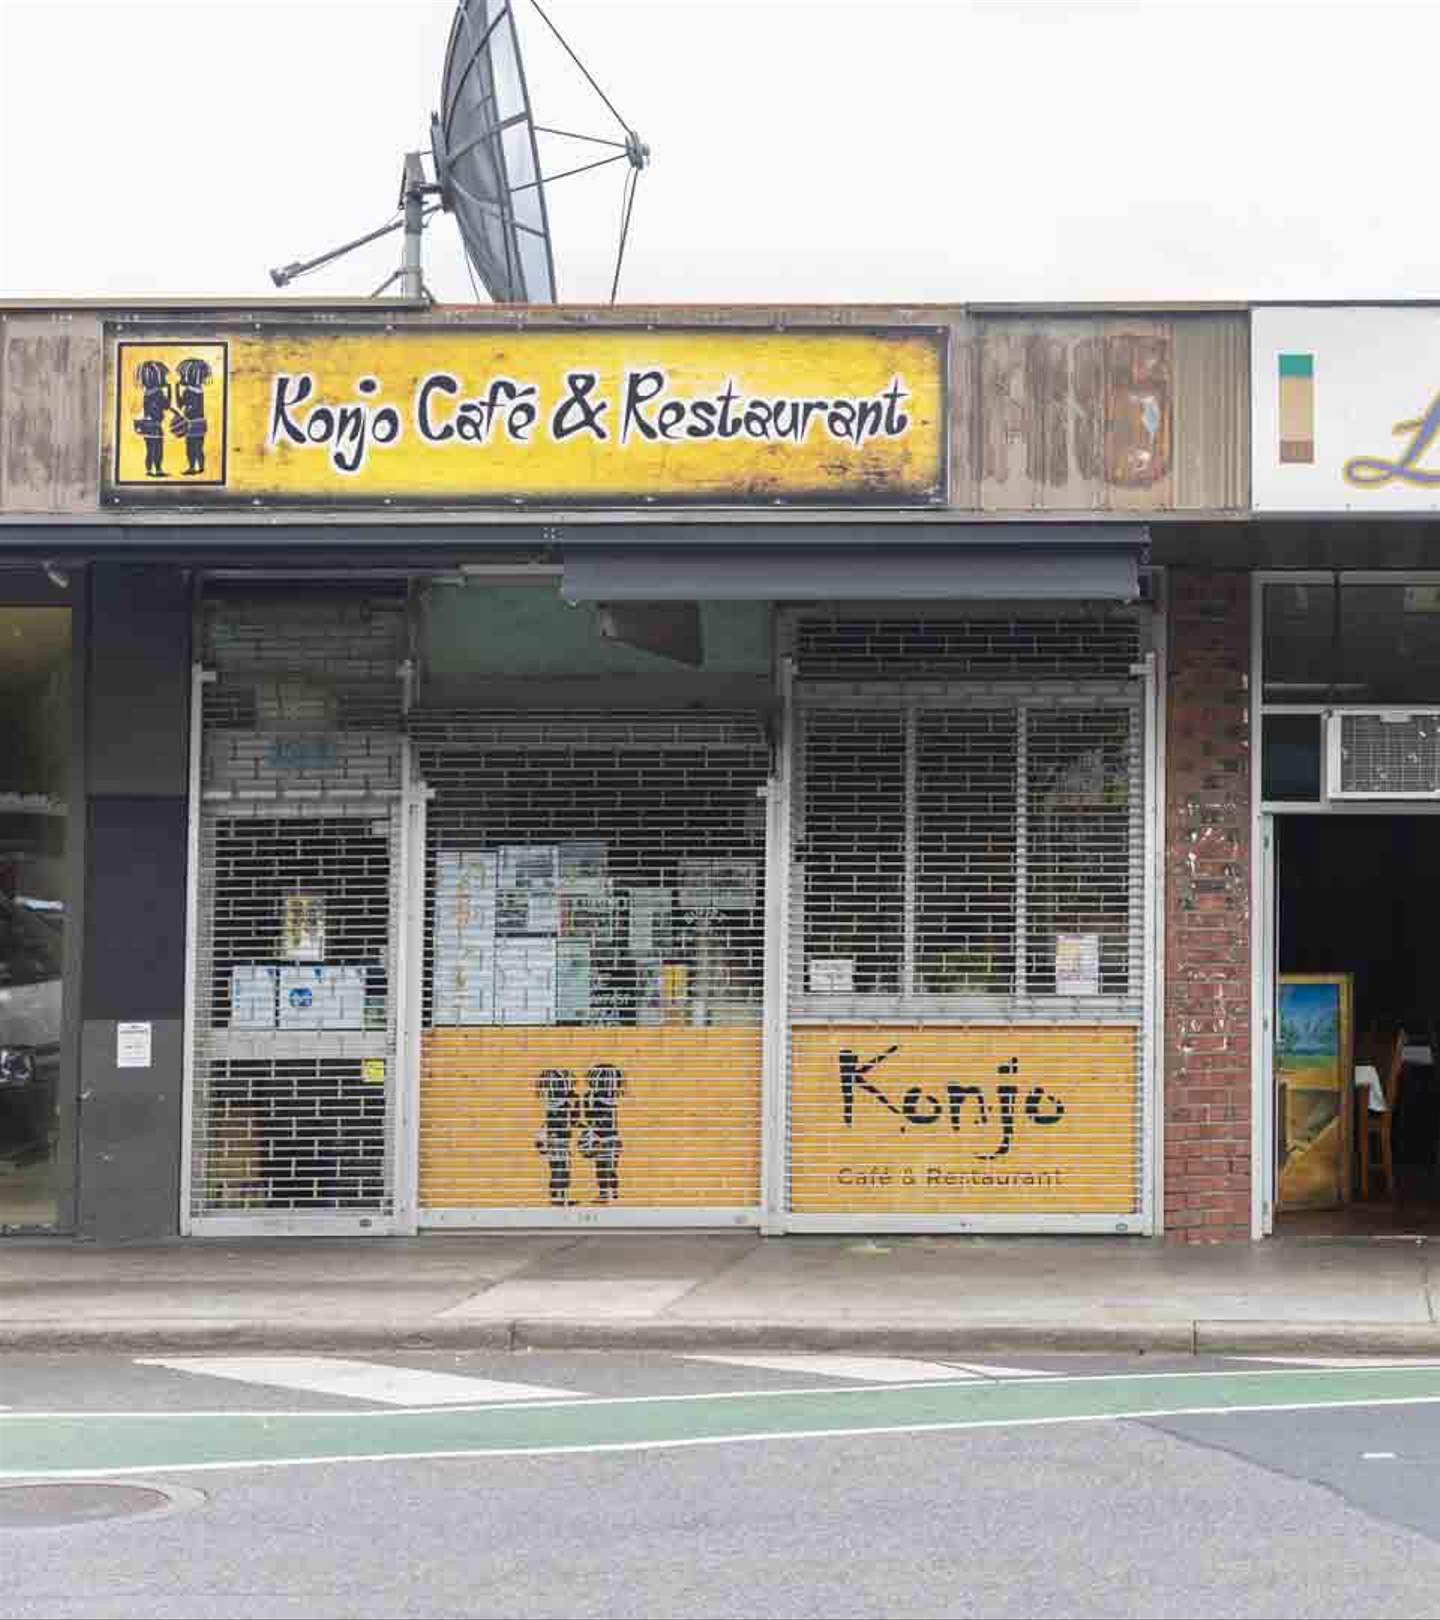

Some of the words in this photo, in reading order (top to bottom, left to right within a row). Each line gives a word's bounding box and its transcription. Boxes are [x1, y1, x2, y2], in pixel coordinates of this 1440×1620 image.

[272, 374, 400, 471] Konjo
[420, 375, 537, 442] Café
[553, 373, 608, 440] &
[622, 370, 909, 444] Restaurant
[839, 1045, 1065, 1160] Konjo
[837, 1165, 892, 1186] Café
[926, 1166, 1065, 1187] Restaurant
